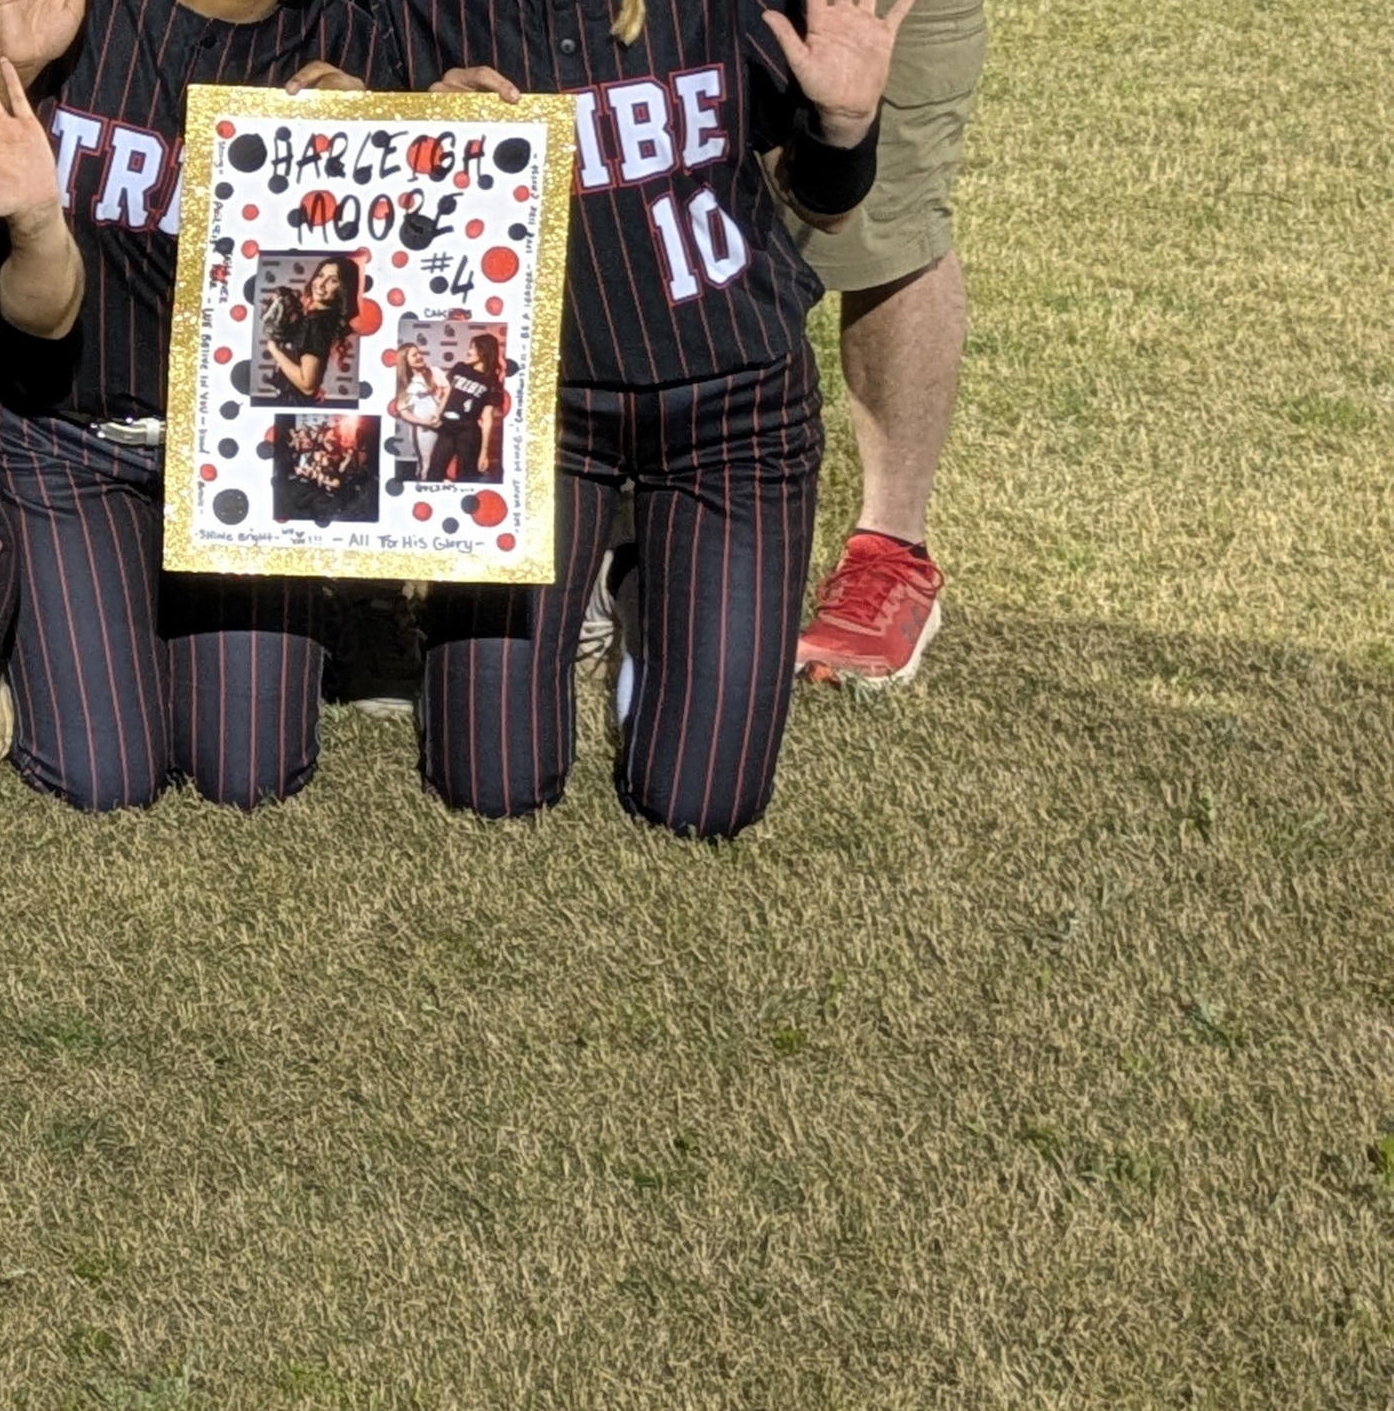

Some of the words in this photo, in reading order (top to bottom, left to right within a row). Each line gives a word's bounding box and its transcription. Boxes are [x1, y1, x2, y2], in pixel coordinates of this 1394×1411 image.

[271, 130, 487, 185] HARLEIGH
[576, 70, 726, 188] IBE
[296, 188, 464, 245] MOORE
[651, 189, 748, 301] 10
